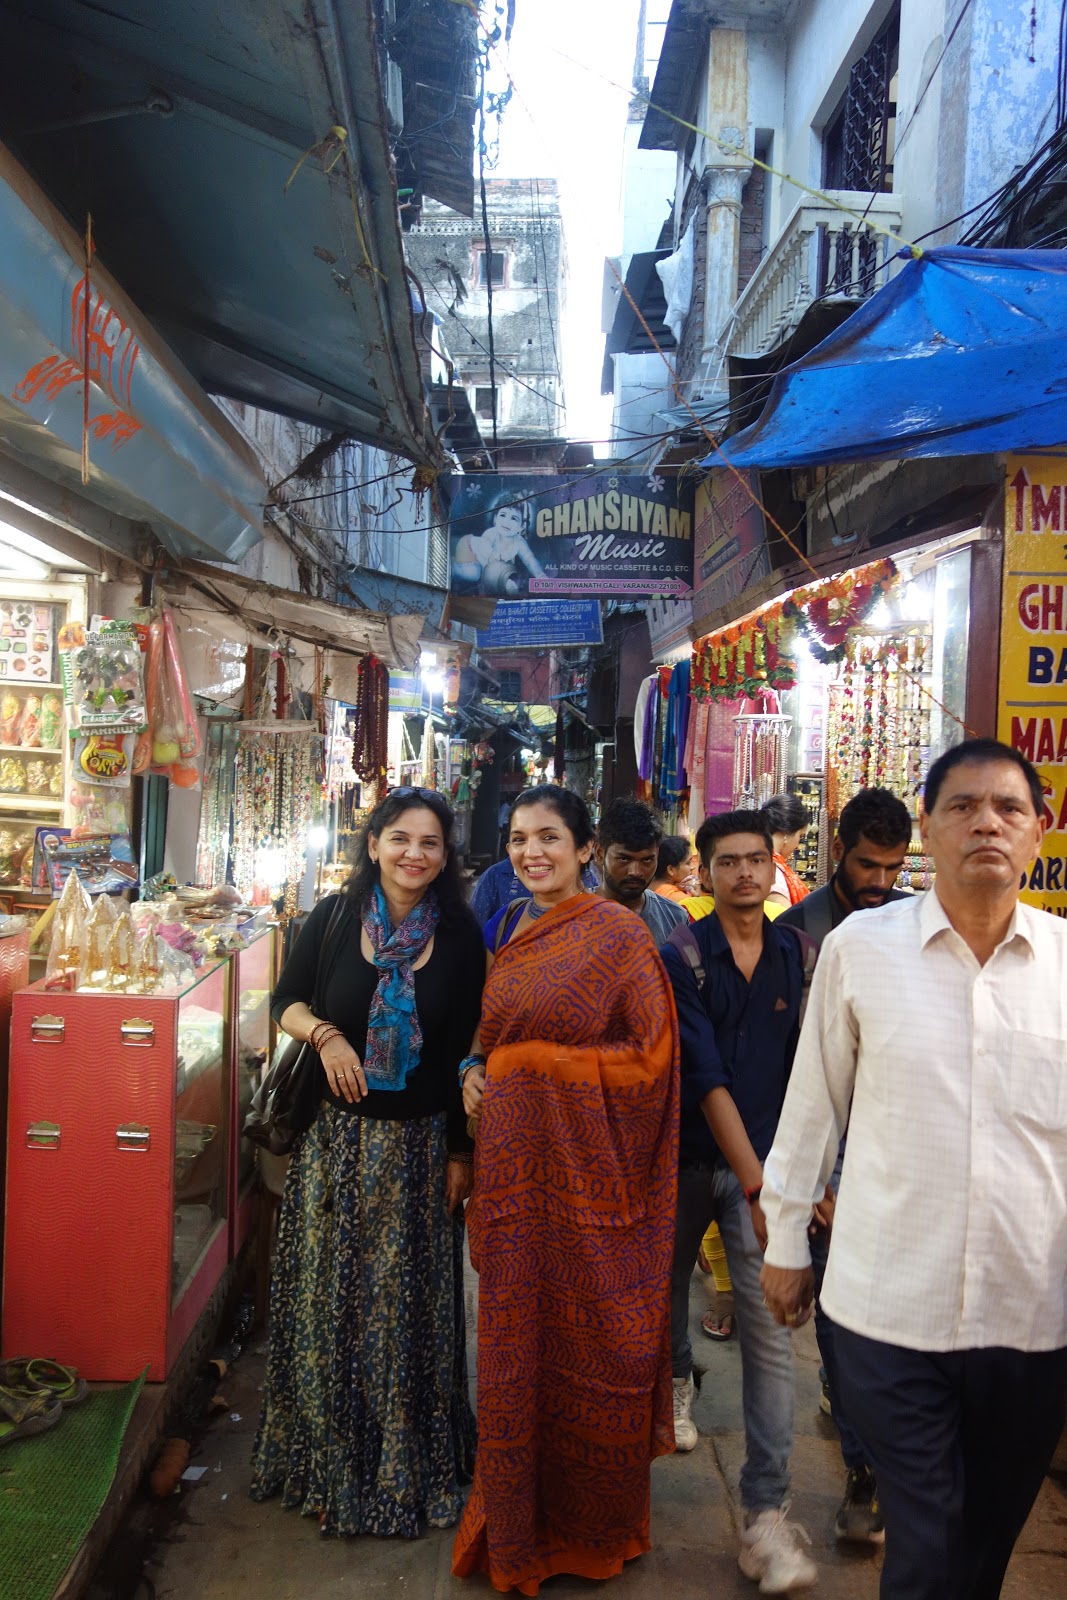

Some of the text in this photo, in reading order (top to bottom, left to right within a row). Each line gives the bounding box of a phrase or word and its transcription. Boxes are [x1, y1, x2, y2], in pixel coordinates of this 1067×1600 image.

[536, 490, 691, 539] GHANSHYAM
[1032, 485, 1067, 531] M
[575, 534, 666, 561] Music
[558, 581, 602, 589] VISHWANATH
[508, 606, 528, 616] BHAKTI
[529, 604, 560, 615] CASSETTES
[560, 603, 593, 614] COLLECTION
[1018, 583, 1067, 630] GH
